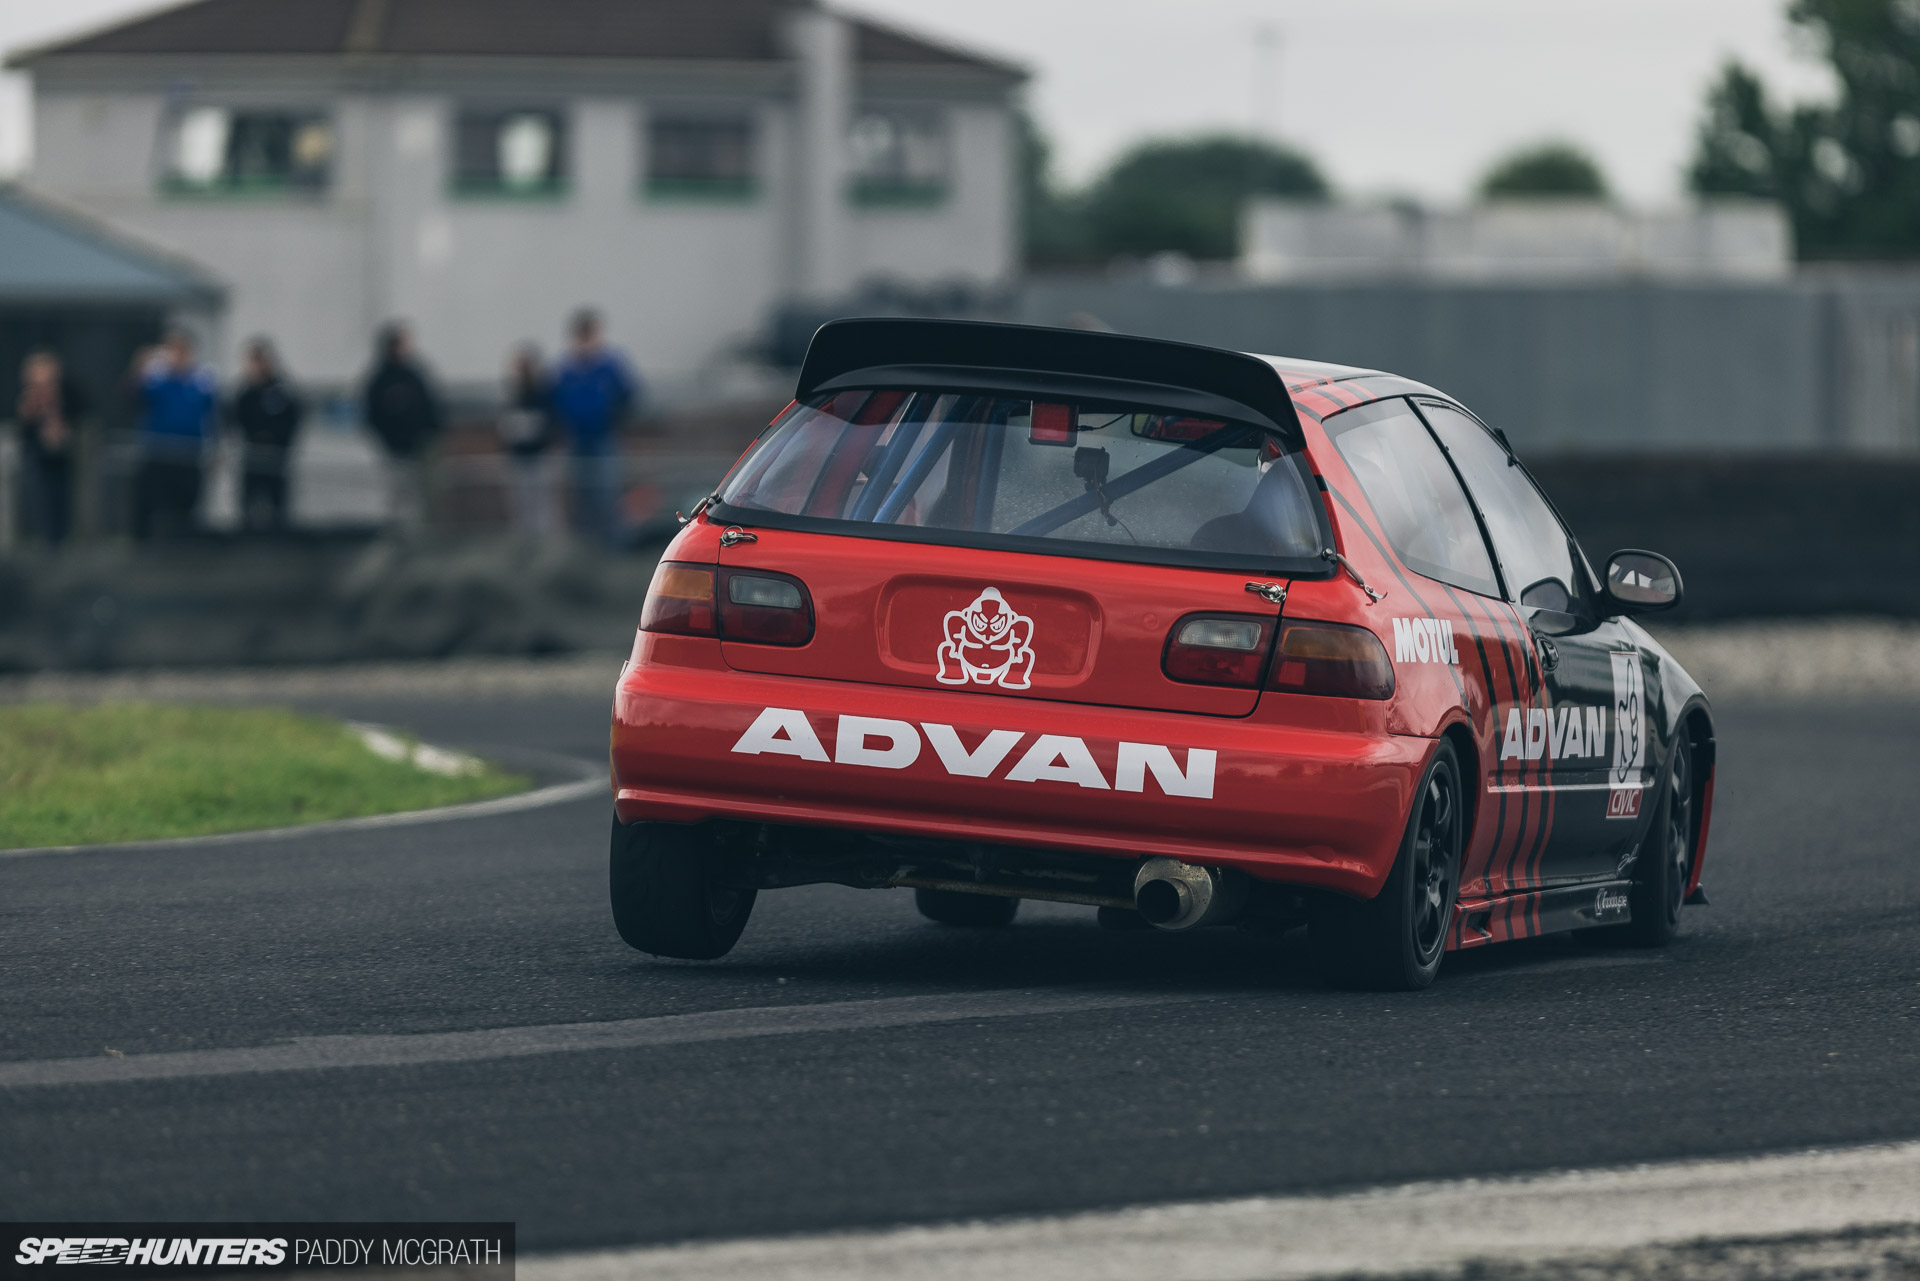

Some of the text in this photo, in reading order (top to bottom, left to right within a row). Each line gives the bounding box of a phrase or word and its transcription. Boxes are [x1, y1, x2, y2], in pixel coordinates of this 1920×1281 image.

[1392, 617, 1459, 664] MOTUL
[731, 707, 1217, 799] ADVAN
[1500, 706, 1606, 760] ADVAN
[1611, 789, 1639, 815] CIVIC
